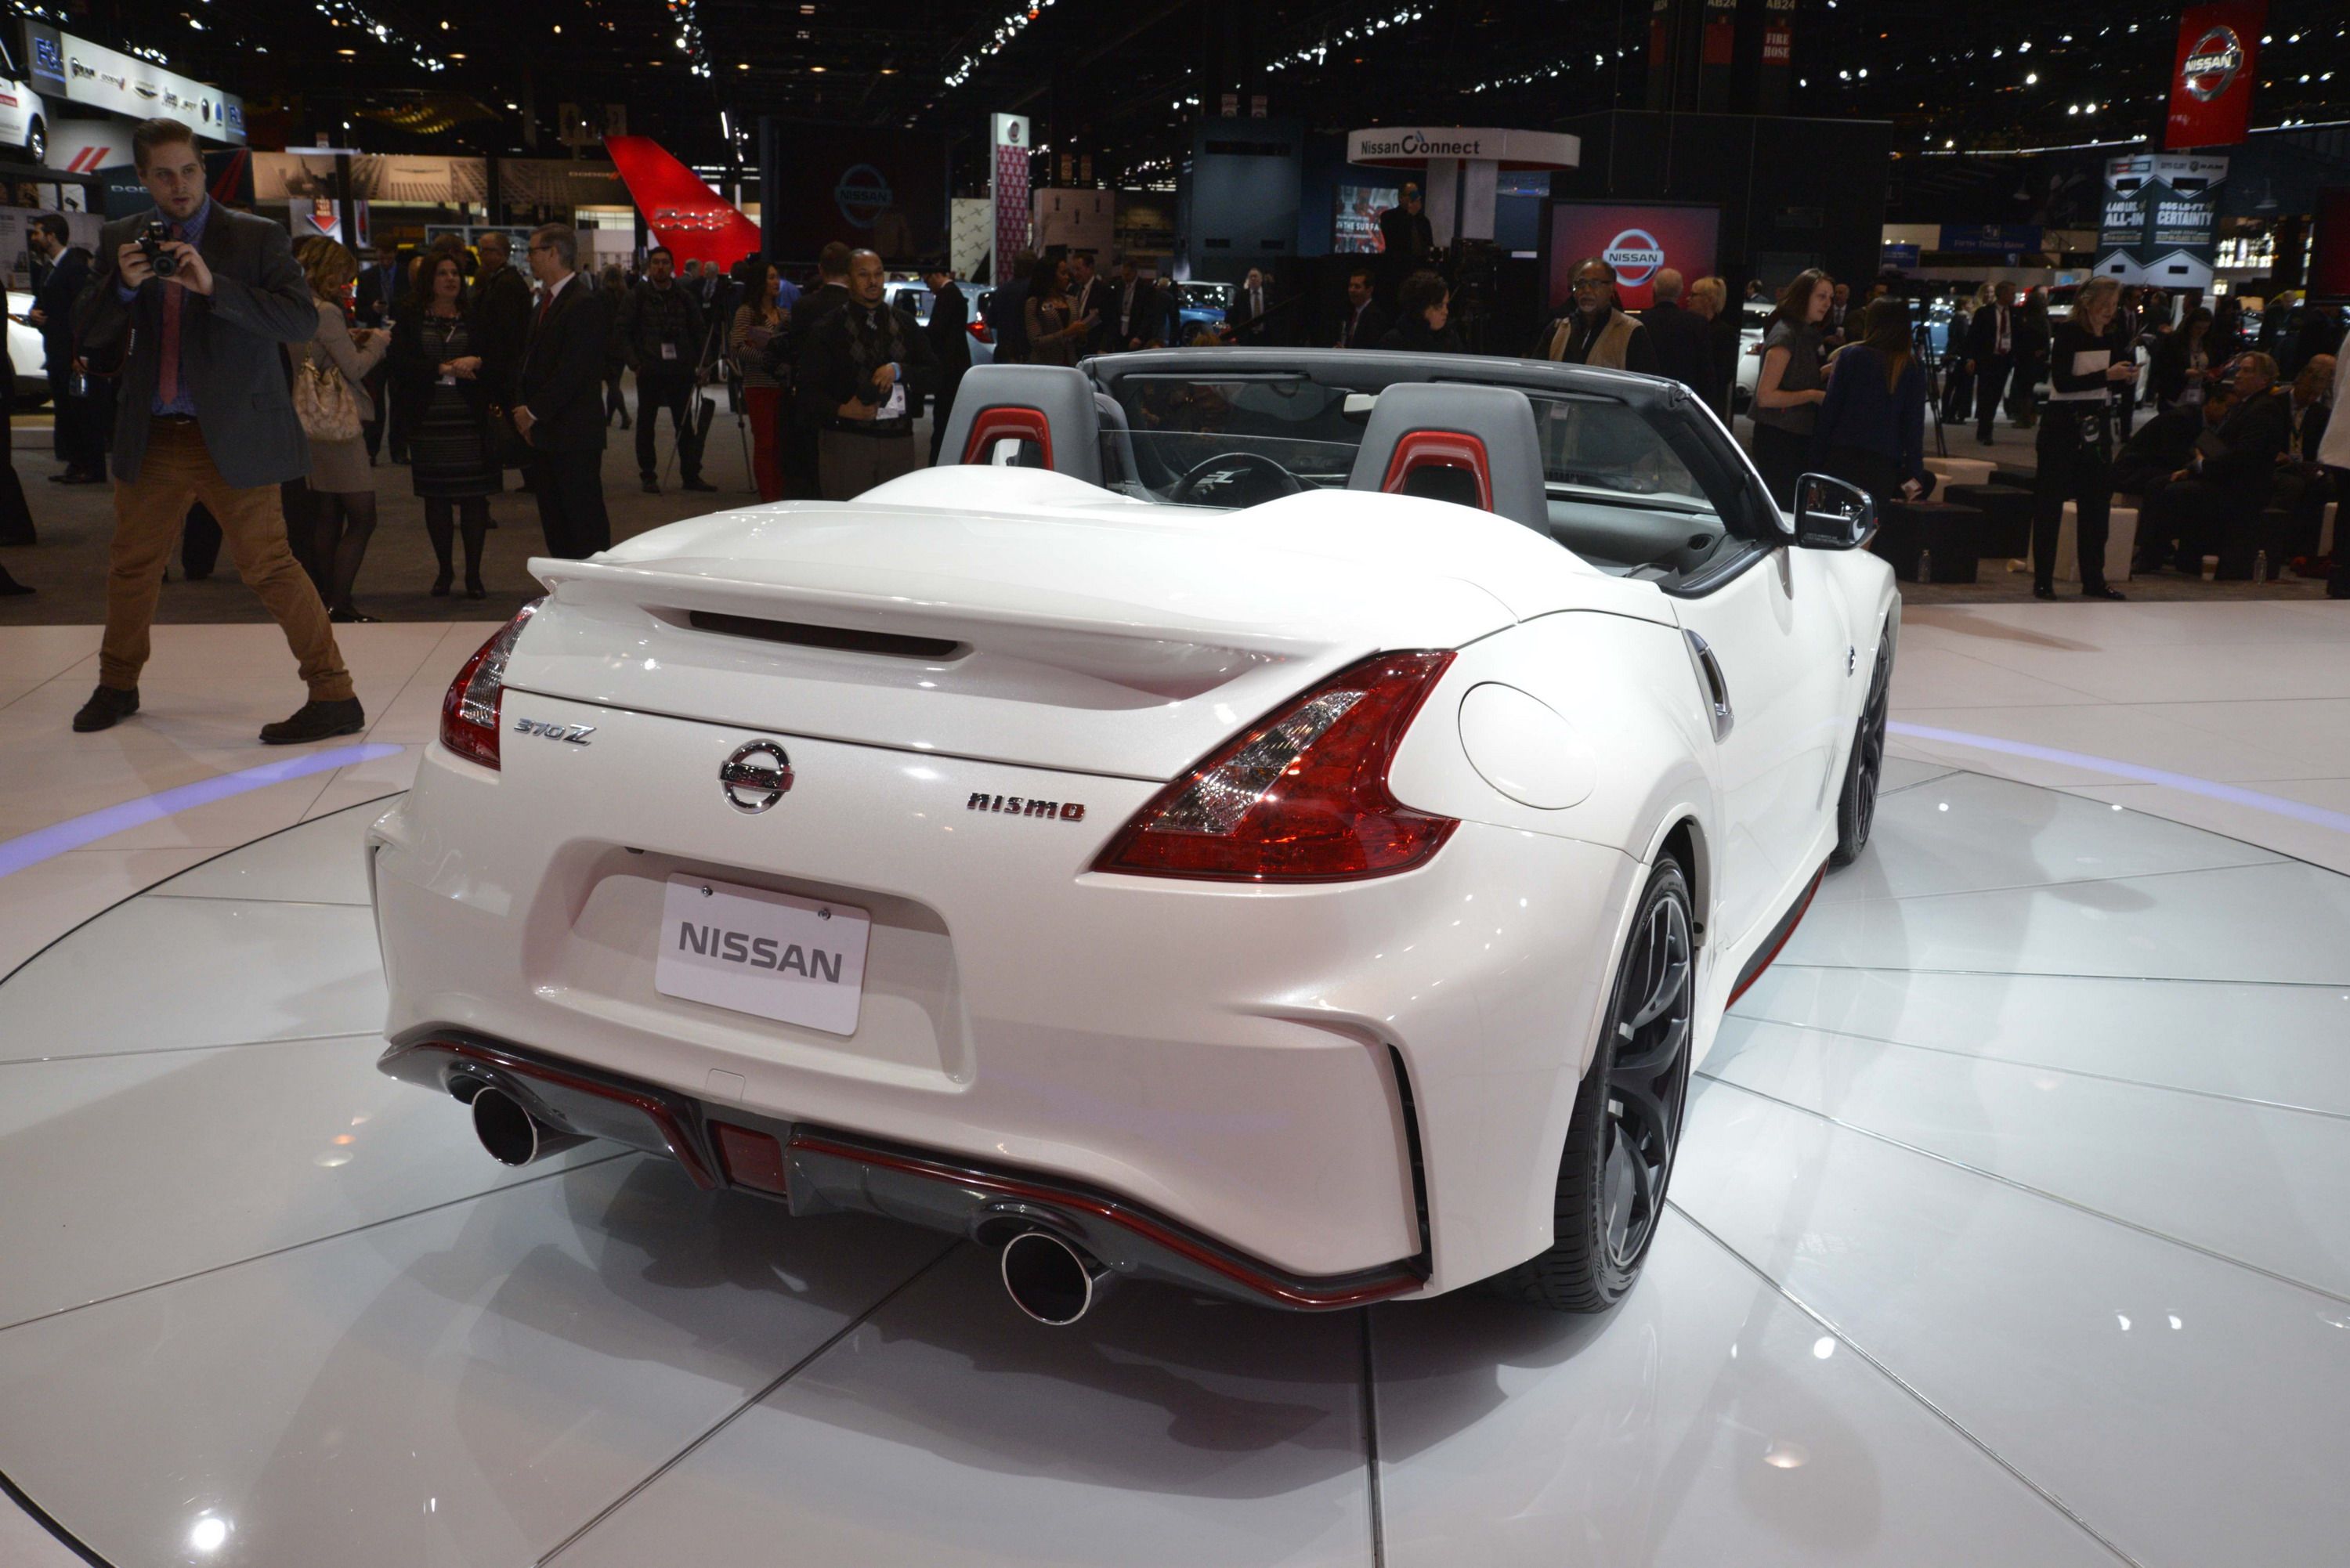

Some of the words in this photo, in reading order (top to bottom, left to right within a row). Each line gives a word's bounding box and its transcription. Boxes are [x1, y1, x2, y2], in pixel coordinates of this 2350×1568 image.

[1766, 33, 1790, 45] FIRE
[1763, 47, 1790, 58] HOSE
[2184, 54, 2232, 72] NISSAN
[110, 185, 150, 193] DOD
[840, 190, 888, 202] NISSAN
[2104, 211, 2146, 226] ALL-IN
[2157, 211, 2214, 226] CERTAINTY
[1356, 222, 1379, 231] SURFA
[1608, 253, 1658, 263] NISSAN
[678, 921, 844, 985] NISSAN
